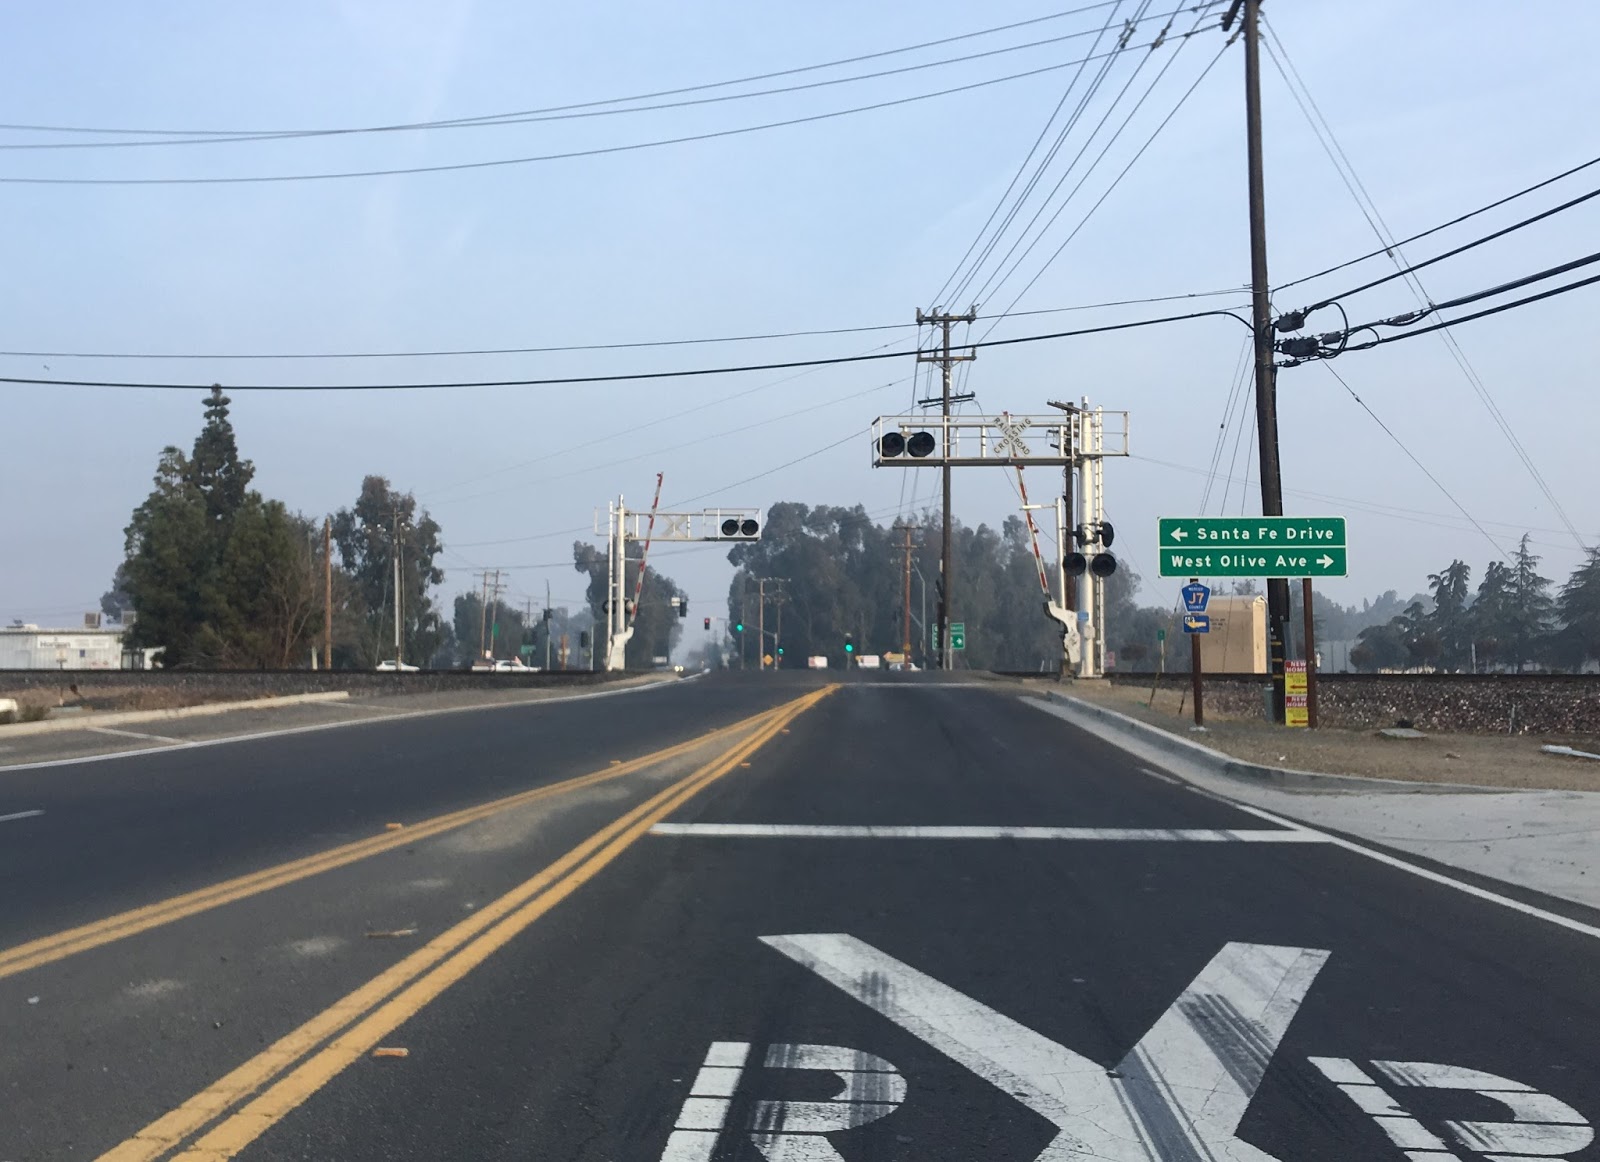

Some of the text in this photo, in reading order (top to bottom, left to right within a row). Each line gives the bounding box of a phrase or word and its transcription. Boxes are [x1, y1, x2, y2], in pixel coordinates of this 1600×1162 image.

[994, 418, 1031, 454] CROSSING
[1197, 526, 1334, 540] Santa Fe Drive
[1171, 555, 1307, 567] West Olive Ave
[1188, 592, 1205, 604] J7
